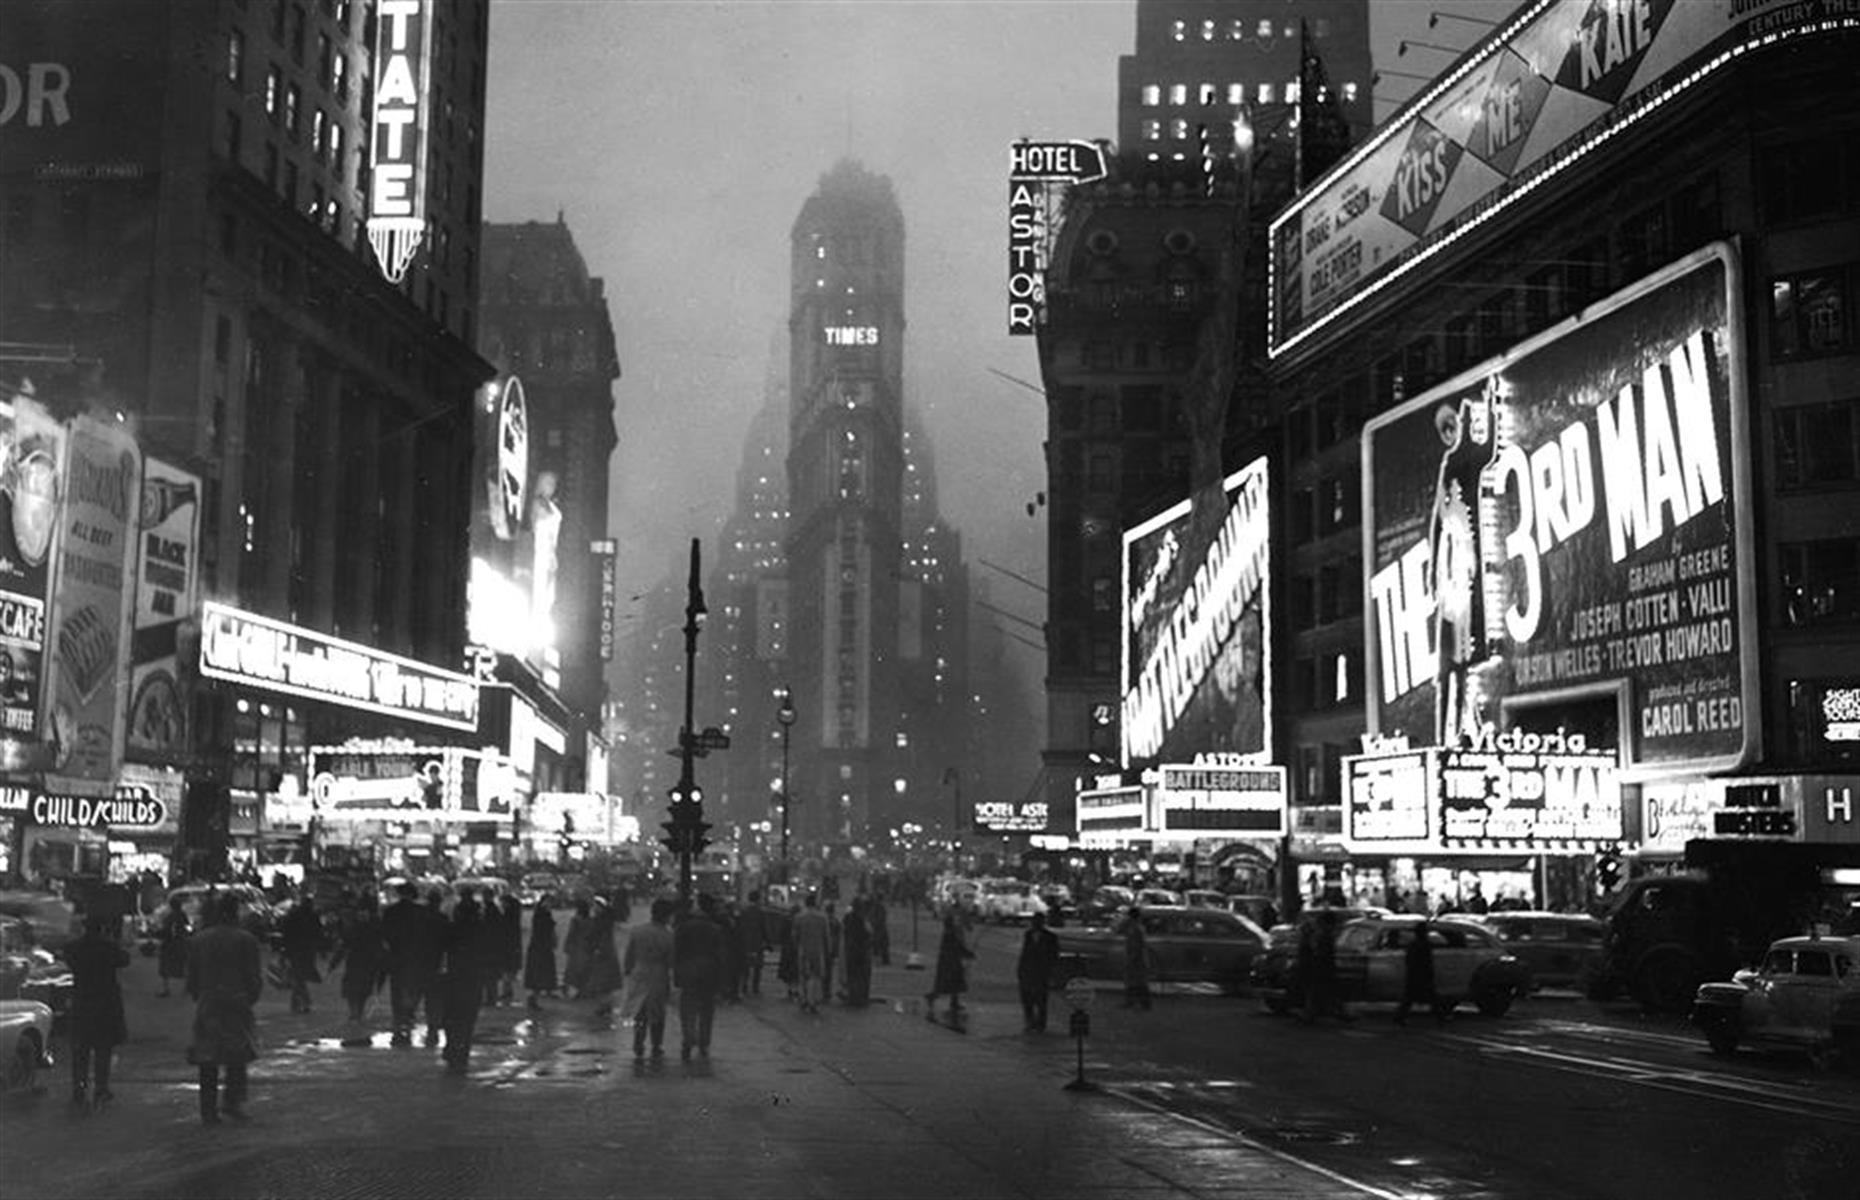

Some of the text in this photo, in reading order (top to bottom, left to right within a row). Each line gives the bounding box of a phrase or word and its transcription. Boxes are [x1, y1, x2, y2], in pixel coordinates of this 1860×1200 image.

[1578, 0, 1651, 90] KATE
[373, 0, 417, 215] TATE
[1010, 146, 1082, 173] HOTEL
[1397, 140, 1448, 220] KISS
[1010, 184, 1034, 328] ASTOR
[824, 326, 879, 345] TIMES
[1370, 329, 1725, 705] THE 3RD MAN
[1628, 544, 1730, 592] GRAHAM GREENE
[1570, 577, 1731, 642] JOSEPH COTTEN VALLI
[1554, 643, 1601, 680] WELLES
[1607, 631, 1663, 672] TREVOR
[1665, 617, 1733, 662] HOWARD
[1463, 722, 1587, 753] Victoria
[1641, 697, 1742, 739] CAROL REED
[101, 800, 157, 823] CHILDS
